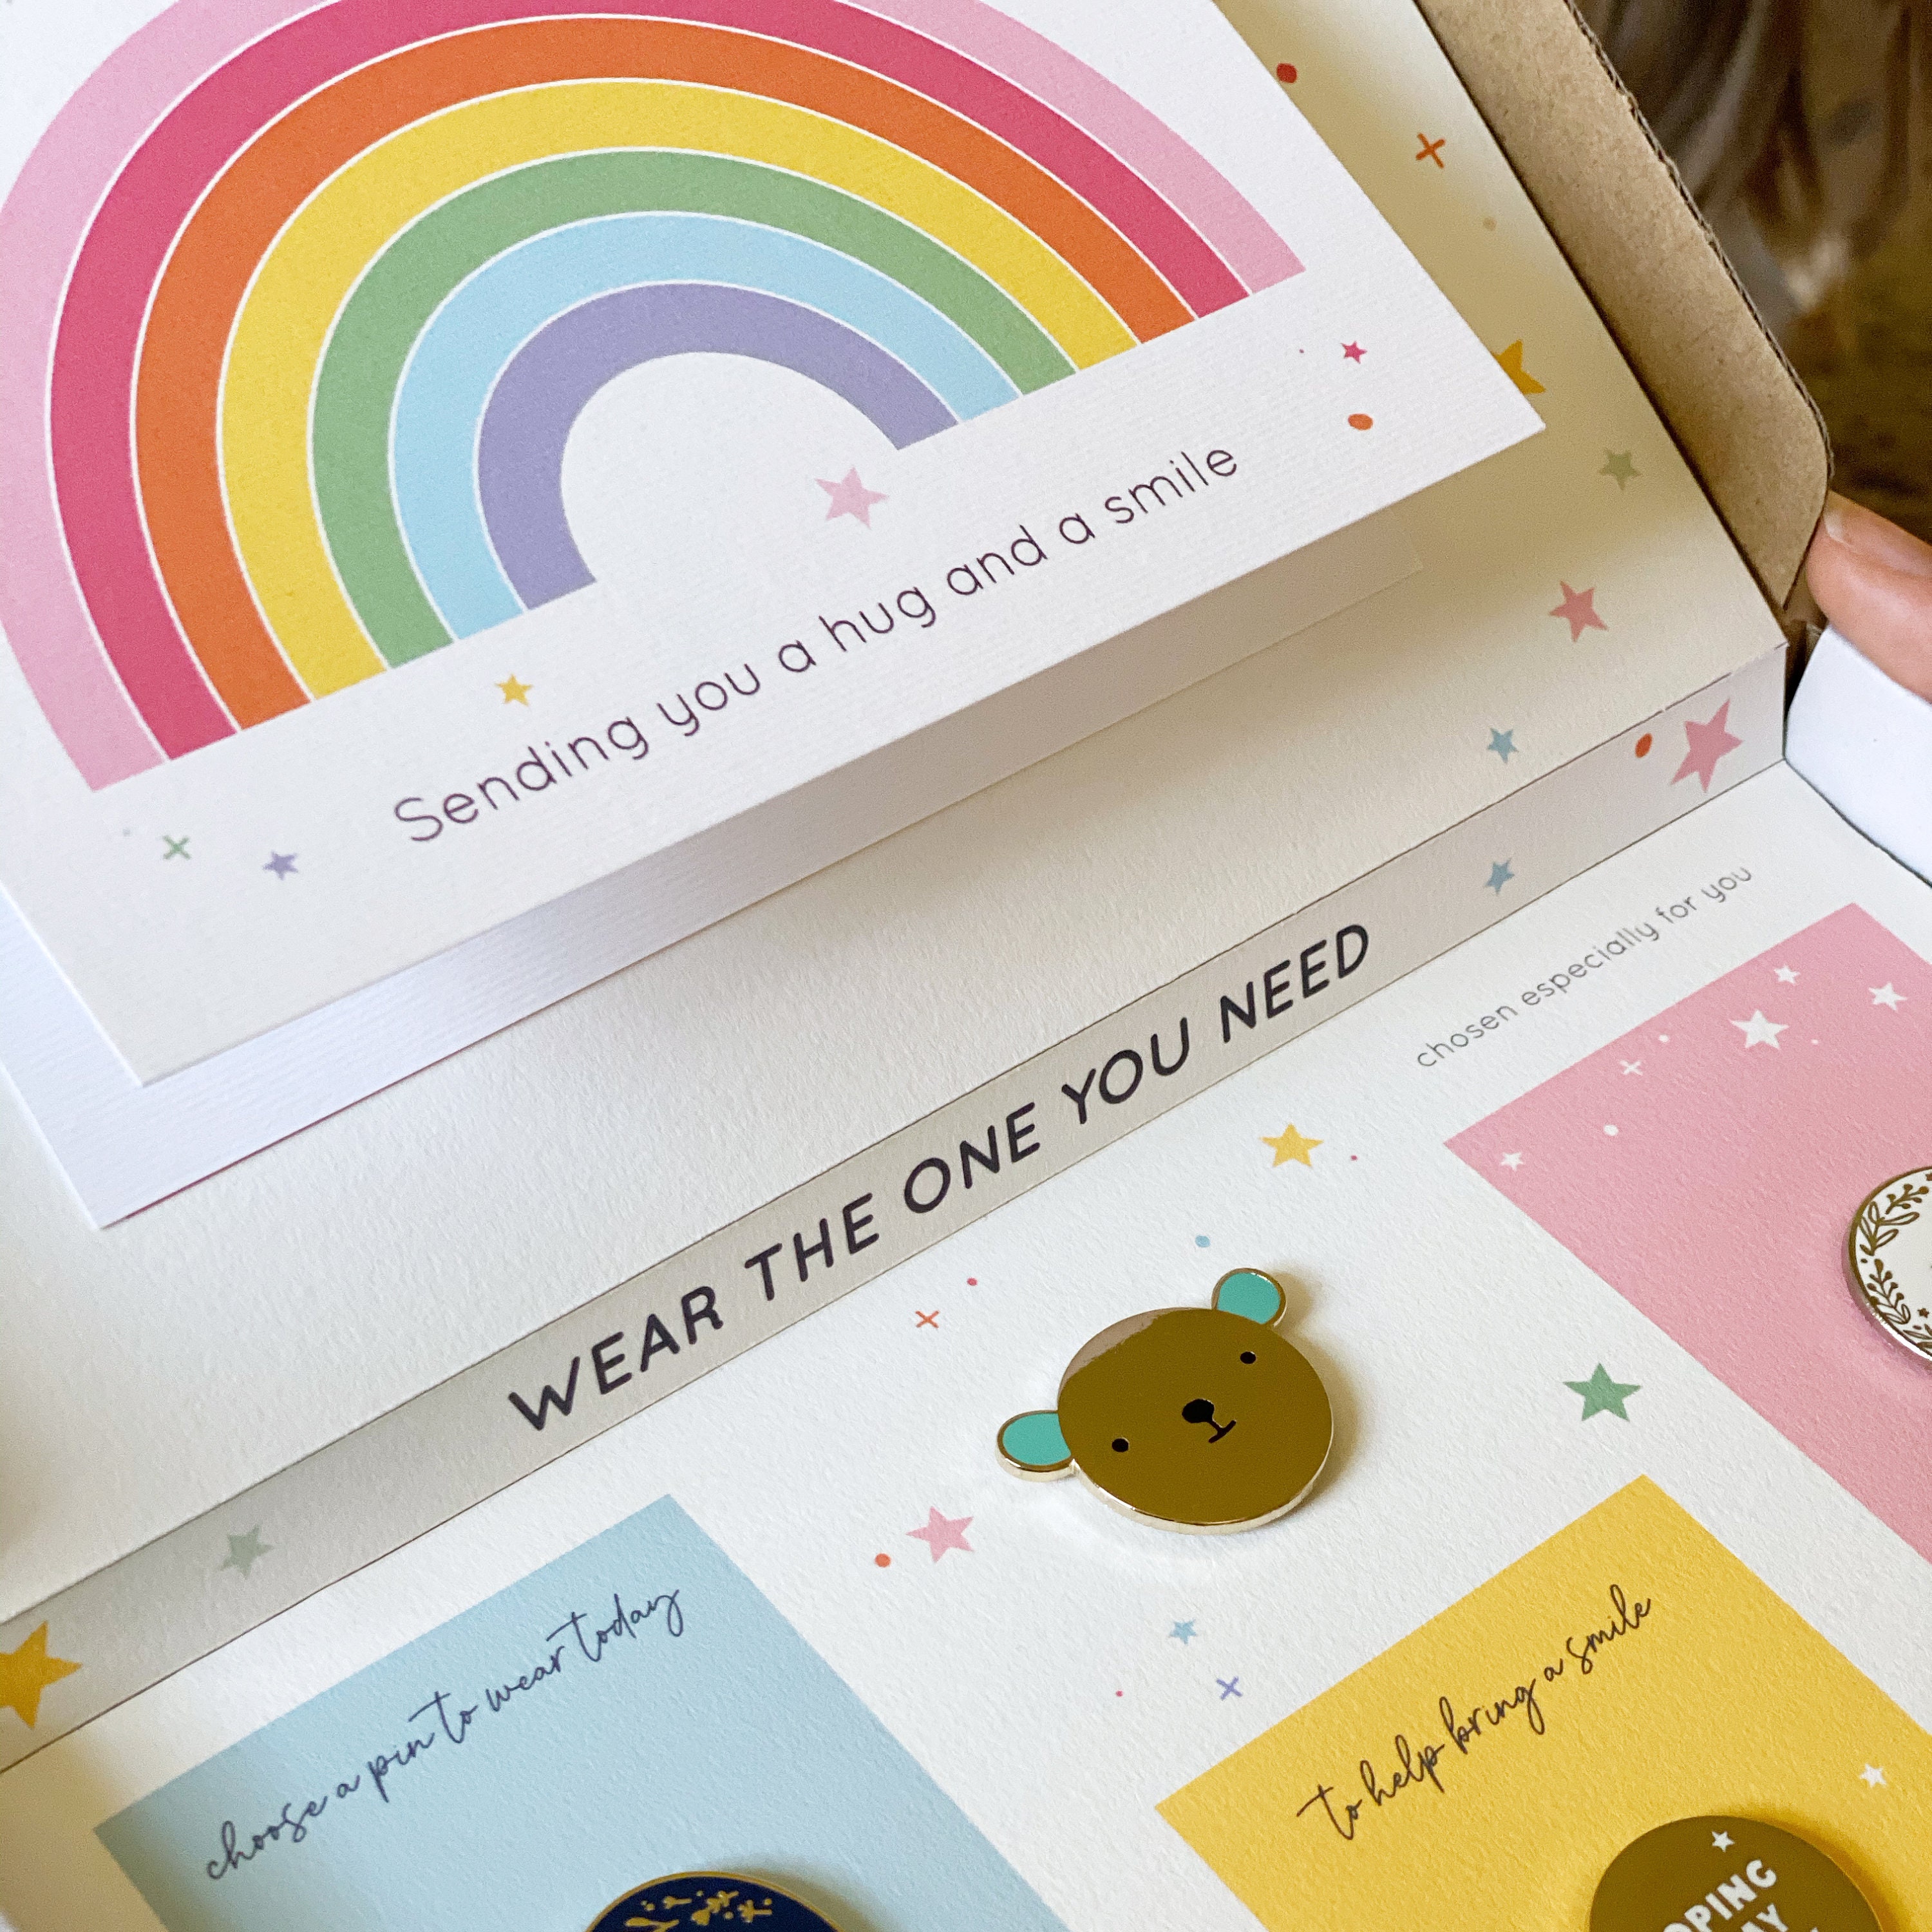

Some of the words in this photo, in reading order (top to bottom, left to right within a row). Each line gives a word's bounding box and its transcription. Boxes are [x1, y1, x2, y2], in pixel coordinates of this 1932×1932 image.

[393, 712, 649, 843] Sending
[658, 659, 760, 736] you
[779, 639, 817, 674] a
[822, 583, 936, 650] hug
[947, 525, 1046, 596] and
[1059, 513, 1094, 545] a
[1104, 443, 1238, 525] smile
[1417, 1003, 1519, 1068] chosen
[1521, 921, 1660, 1006] especially
[1657, 896, 1697, 924] for
[1703, 867, 1753, 904] you
[507, 1285, 724, 1431] WEAR
[743, 1193, 880, 1302] THE
[904, 1103, 1042, 1214] ONE
[1061, 1017, 1192, 1125] YOU
[1220, 923, 1370, 1043] NEED
[207, 1795, 330, 1880] choose
[336, 1776, 360, 1798] a
[368, 1732, 435, 1802] pin
[408, 1691, 477, 1744] to
[486, 1646, 564, 1711] wear
[547, 1589, 684, 1662] today
[1296, 1785, 1362, 1839] to
[1360, 1734, 1444, 1806] help
[1440, 1678, 1544, 1754] bring
[1544, 1658, 1564, 1681] a
[1567, 1584, 1651, 1674] smile
